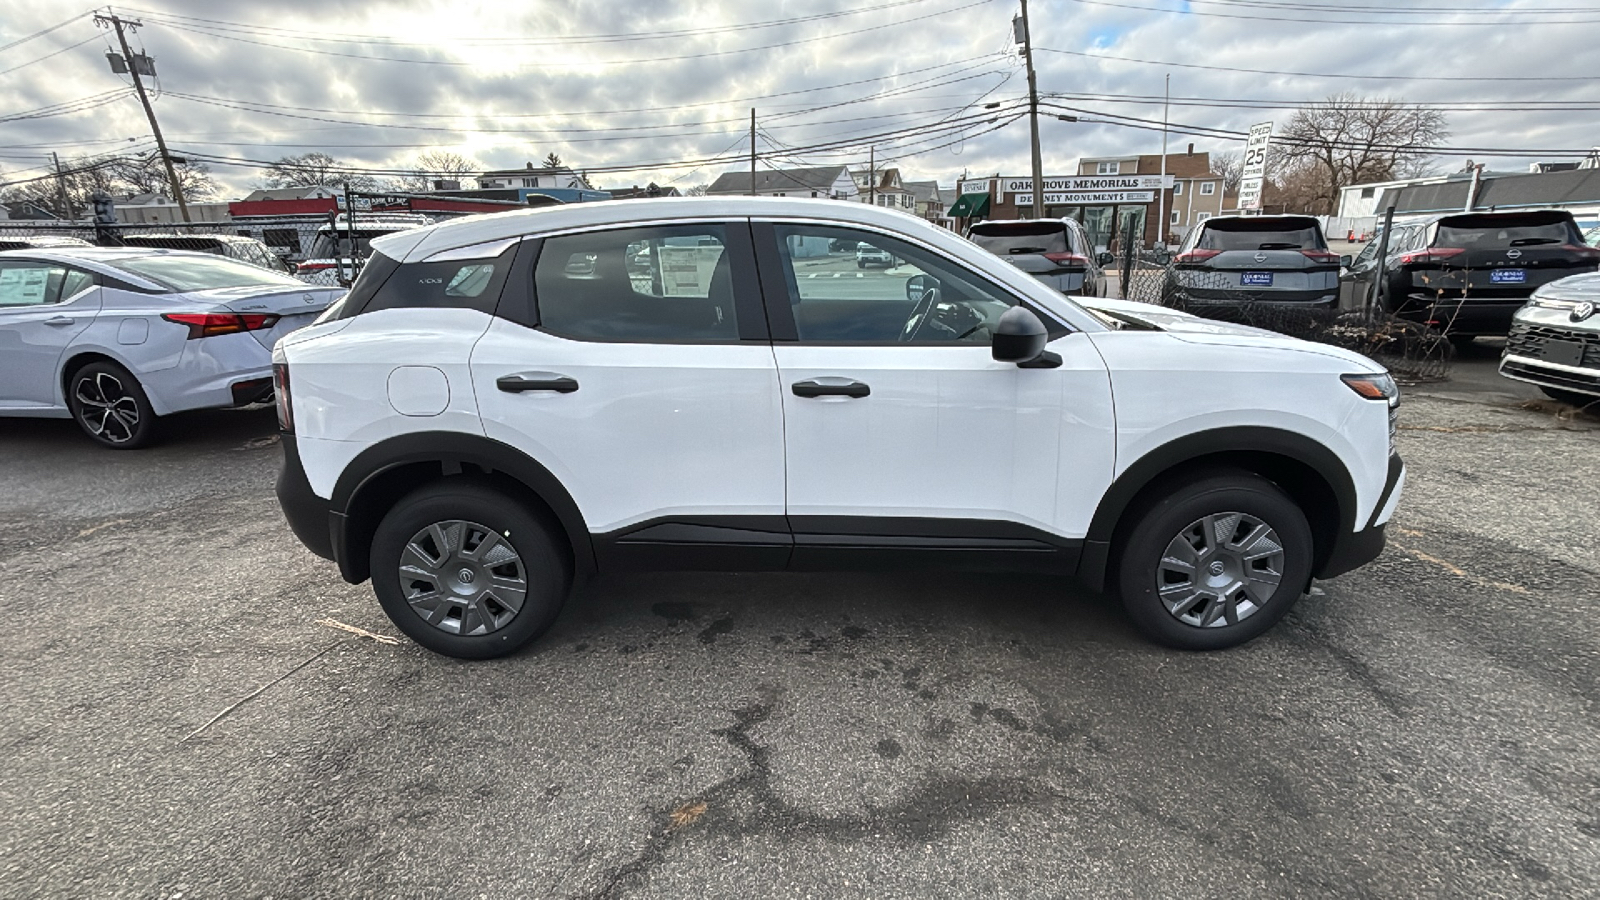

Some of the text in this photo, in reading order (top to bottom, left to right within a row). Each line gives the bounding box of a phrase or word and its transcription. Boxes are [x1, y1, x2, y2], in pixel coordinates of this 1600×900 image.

[1251, 127, 1270, 136] SPEED
[1250, 137, 1266, 145] LIMIT
[1246, 148, 1265, 166] 25
[1010, 181, 1032, 190] OAK
[1042, 180, 1070, 189] ROVE
[1073, 179, 1139, 189] MEMORIALS
[1020, 194, 1062, 203] DENEY
[1065, 193, 1124, 201] MONUMENTS
